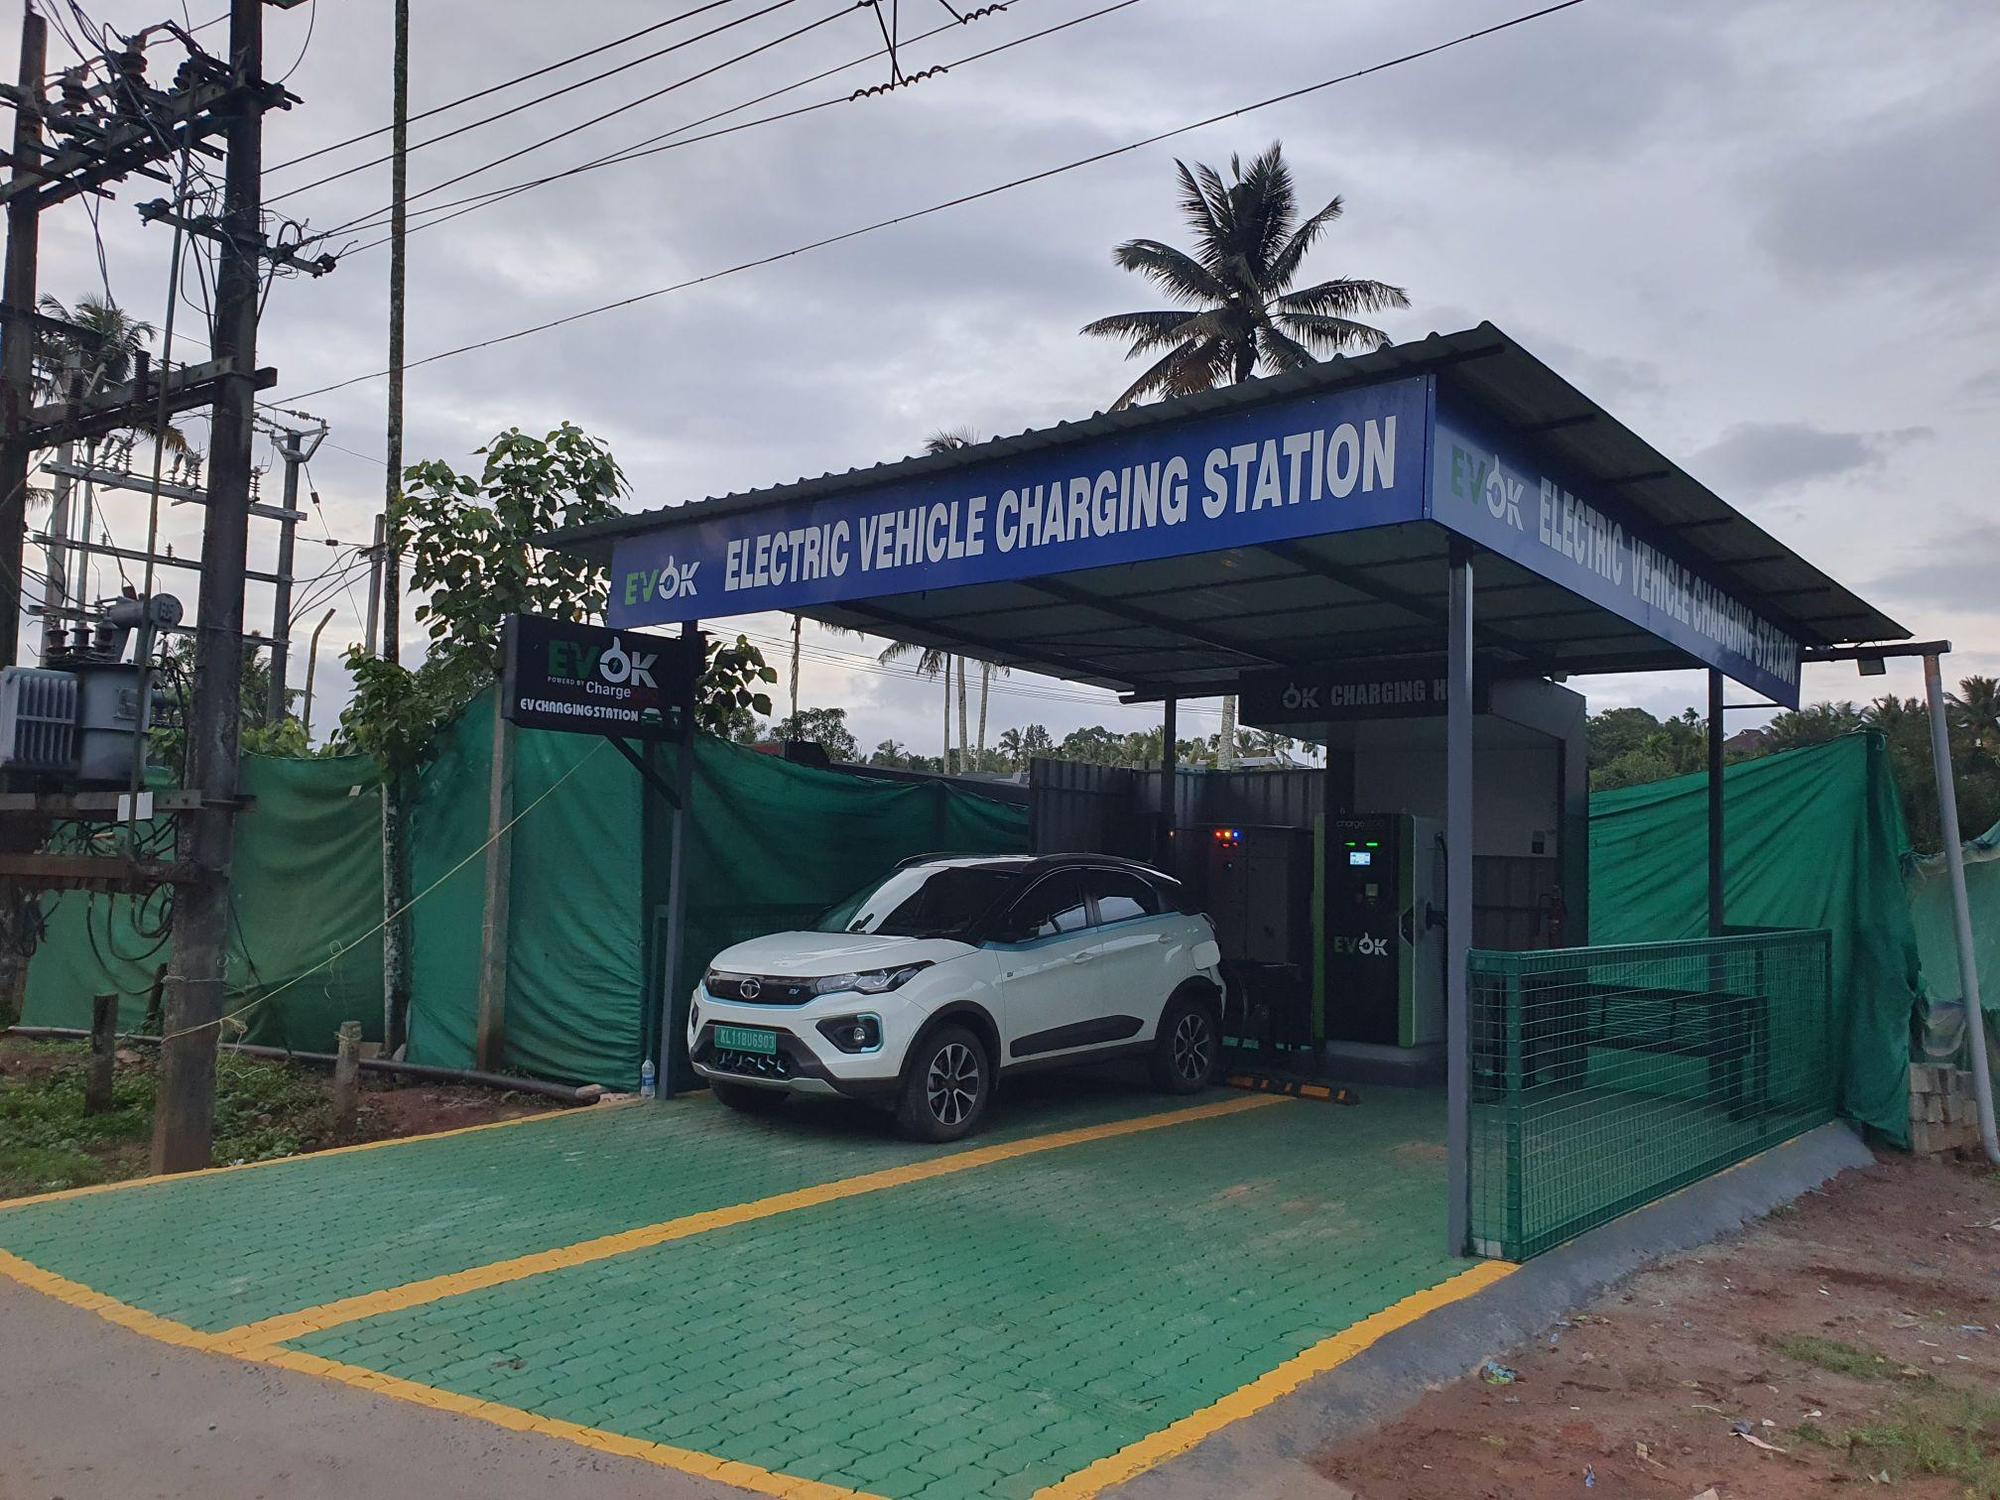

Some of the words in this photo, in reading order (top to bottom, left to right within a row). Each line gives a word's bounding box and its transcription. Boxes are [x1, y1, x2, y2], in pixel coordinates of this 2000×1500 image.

[625, 555, 700, 606] EVOK
[724, 520, 850, 592] ELECTRIC
[859, 496, 987, 572] VEHICLE
[995, 455, 1188, 554] CHARGING
[1201, 415, 1397, 519] STATION
[1451, 444, 1525, 532] EVOK
[1539, 476, 1625, 586] ELECTRIC
[1631, 535, 1691, 625] VEHICLE
[1692, 575, 1754, 661] CHARGING
[1755, 616, 1799, 686] STATION
[547, 636, 660, 689] EVOK
[520, 698, 535, 711] EV
[593, 706, 639, 722] STATION
[585, 681, 632, 700] Charge
[1331, 679, 1426, 706] CHARGING
